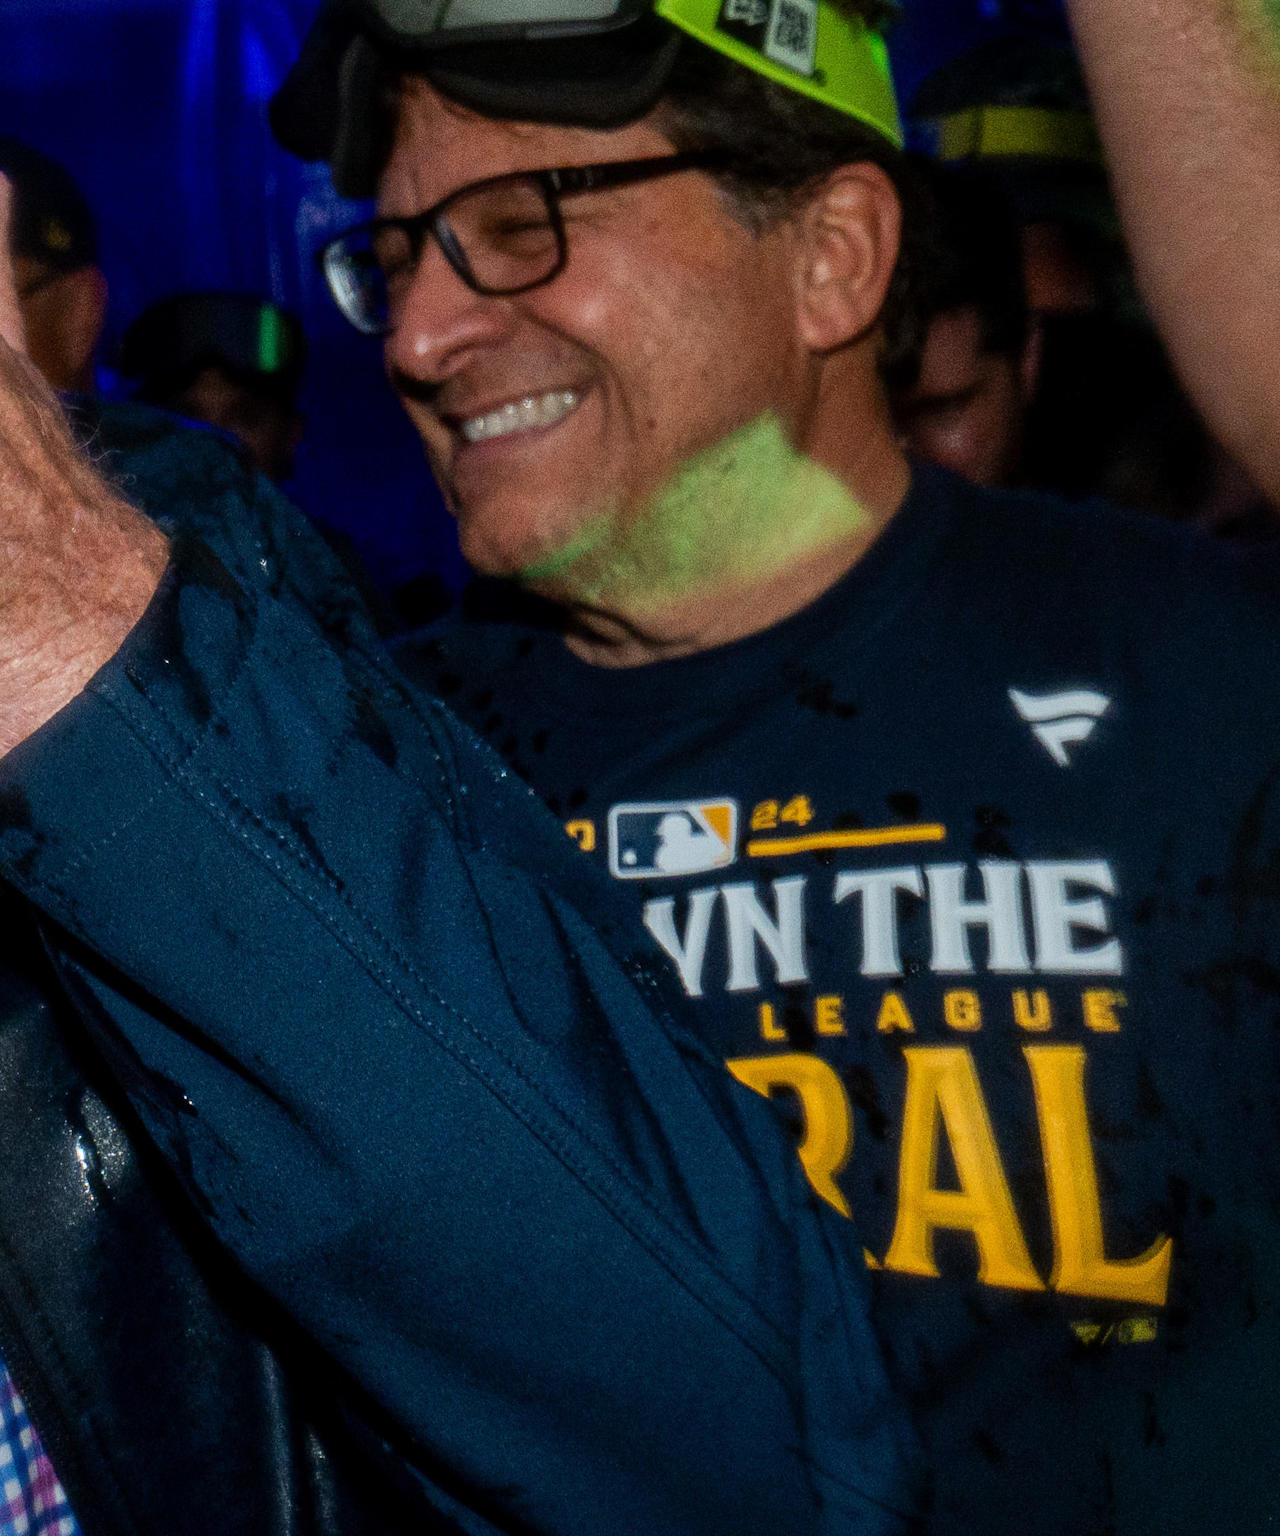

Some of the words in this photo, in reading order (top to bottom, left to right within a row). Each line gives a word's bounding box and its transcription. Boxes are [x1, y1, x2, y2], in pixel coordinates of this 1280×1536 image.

[750, 795, 814, 830] 24
[832, 859, 1123, 977] THE
[759, 989, 1122, 1041] LEAGUE
